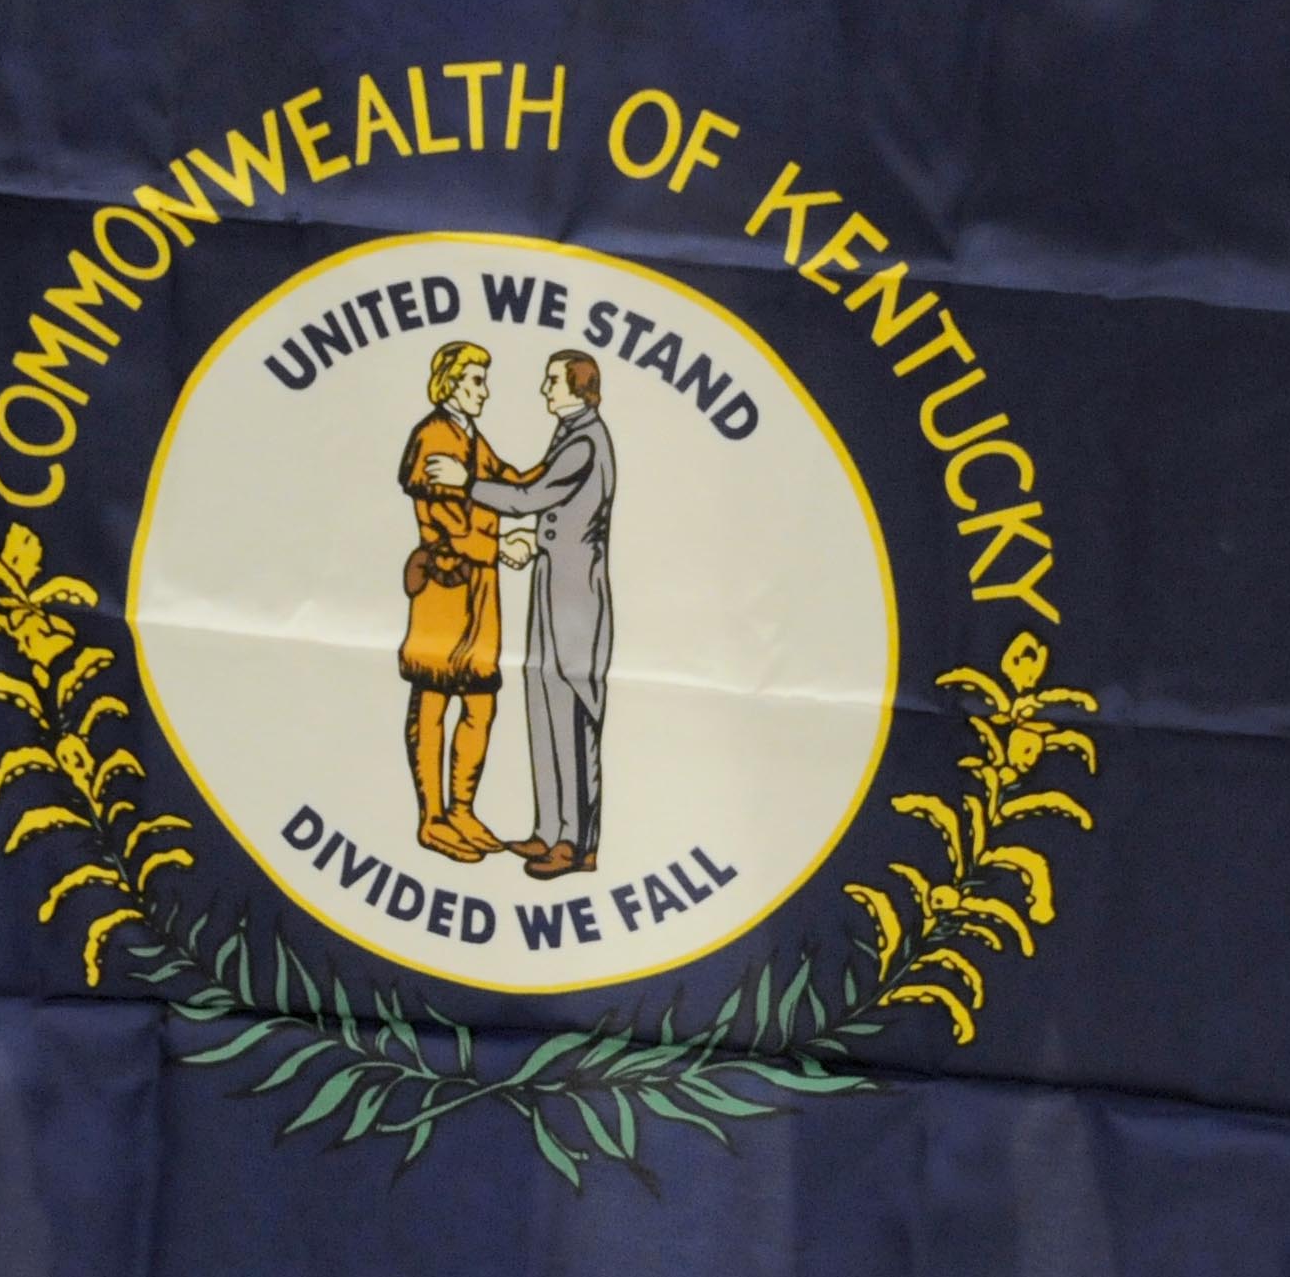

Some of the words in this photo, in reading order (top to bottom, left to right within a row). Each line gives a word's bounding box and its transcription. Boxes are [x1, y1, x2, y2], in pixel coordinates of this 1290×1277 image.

[265, 274, 461, 390] UNITED
[482, 273, 568, 332] WE
[583, 301, 759, 441] STAND
[608, 88, 741, 193] OF
[745, 162, 1061, 625] KENTUCKY
[281, 805, 496, 944] DIVIDED
[515, 897, 602, 951] WE
[611, 846, 738, 932] FALL
